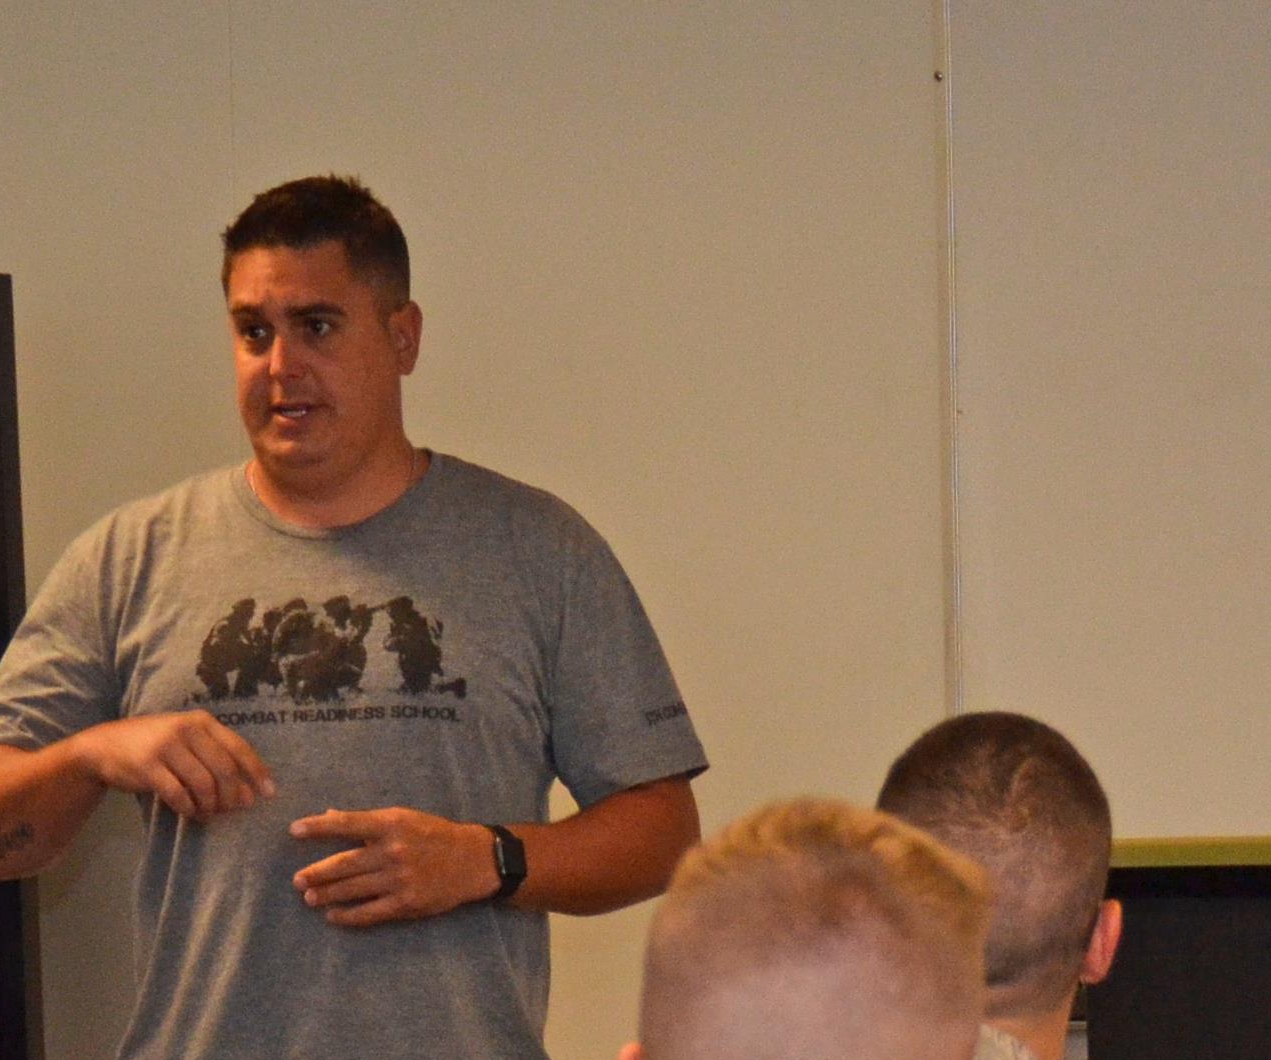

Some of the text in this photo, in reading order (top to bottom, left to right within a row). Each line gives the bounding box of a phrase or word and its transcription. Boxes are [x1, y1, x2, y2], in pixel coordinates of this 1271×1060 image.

[217, 704, 460, 727] COMBAT READINESS SCHOOL
